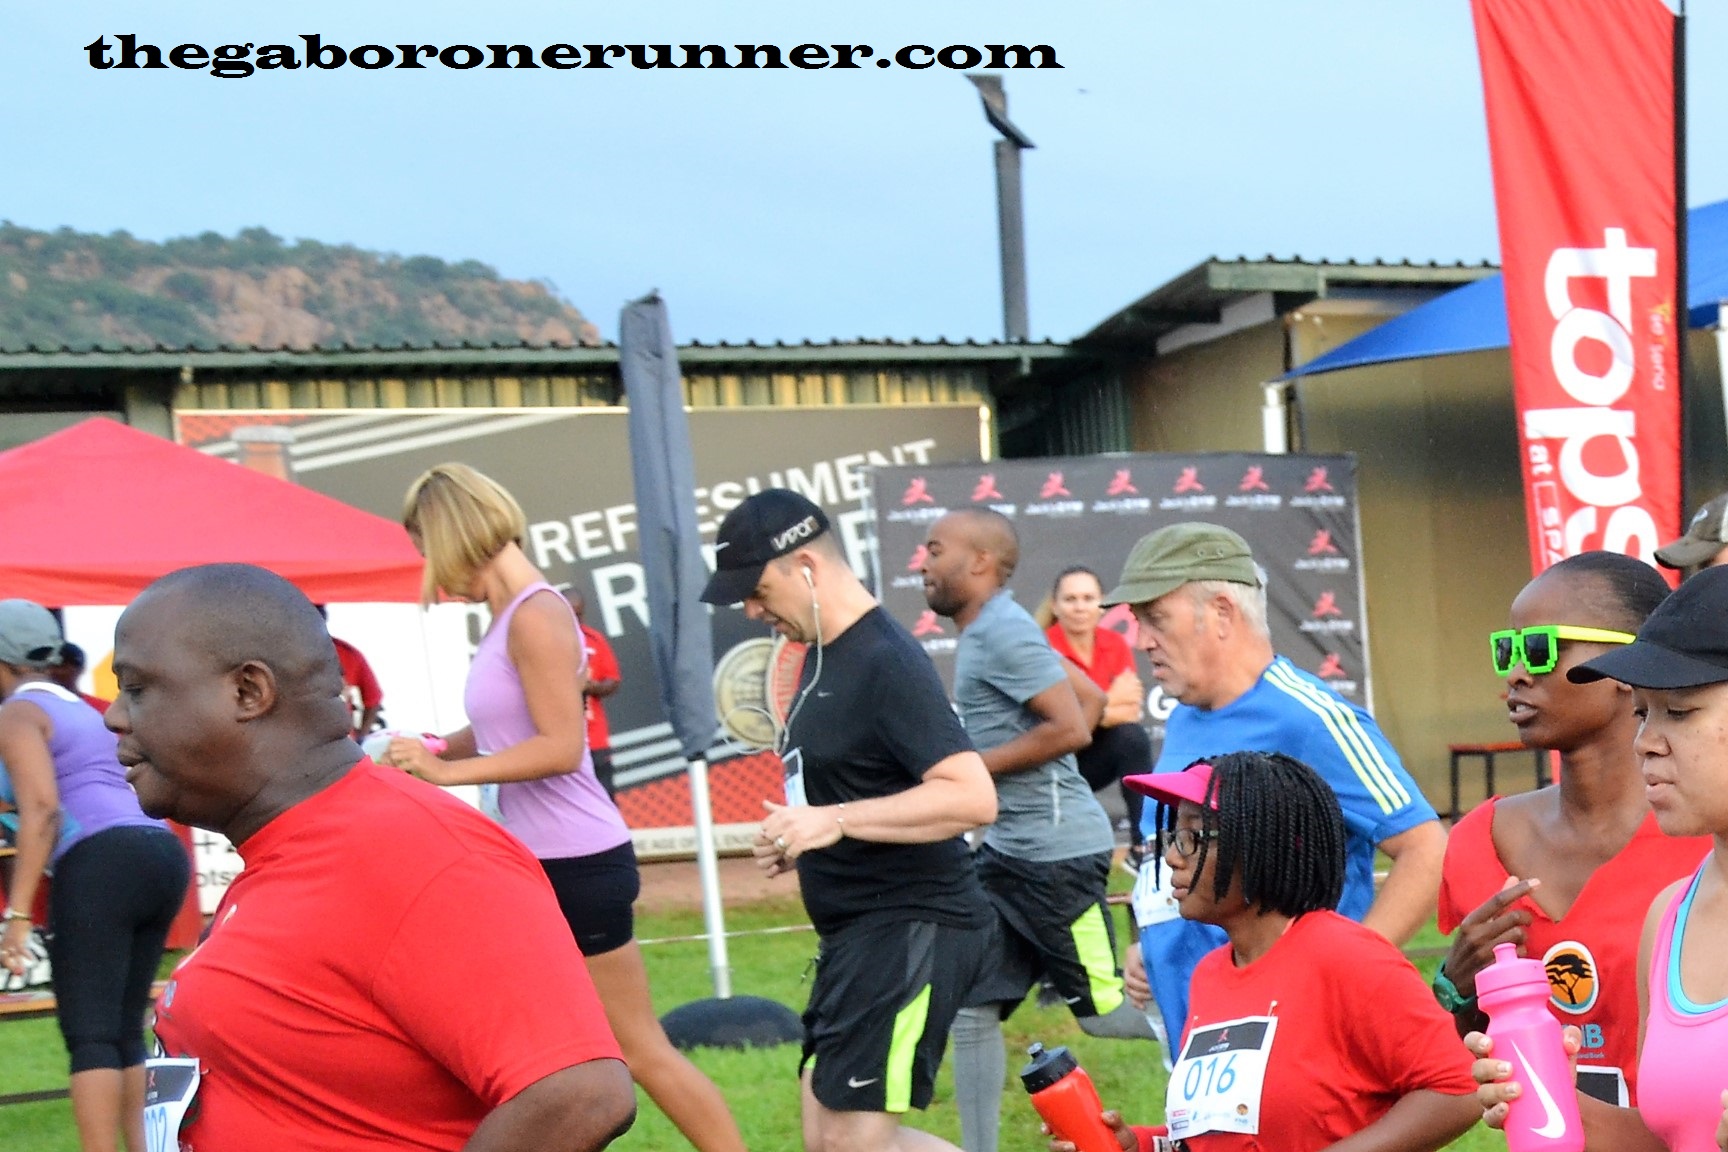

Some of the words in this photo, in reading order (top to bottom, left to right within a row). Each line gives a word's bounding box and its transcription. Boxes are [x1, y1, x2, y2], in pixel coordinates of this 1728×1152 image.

[1523, 226, 1659, 569] tops
[1541, 503, 1566, 572] SPA
[1183, 1052, 1238, 1101] 016
